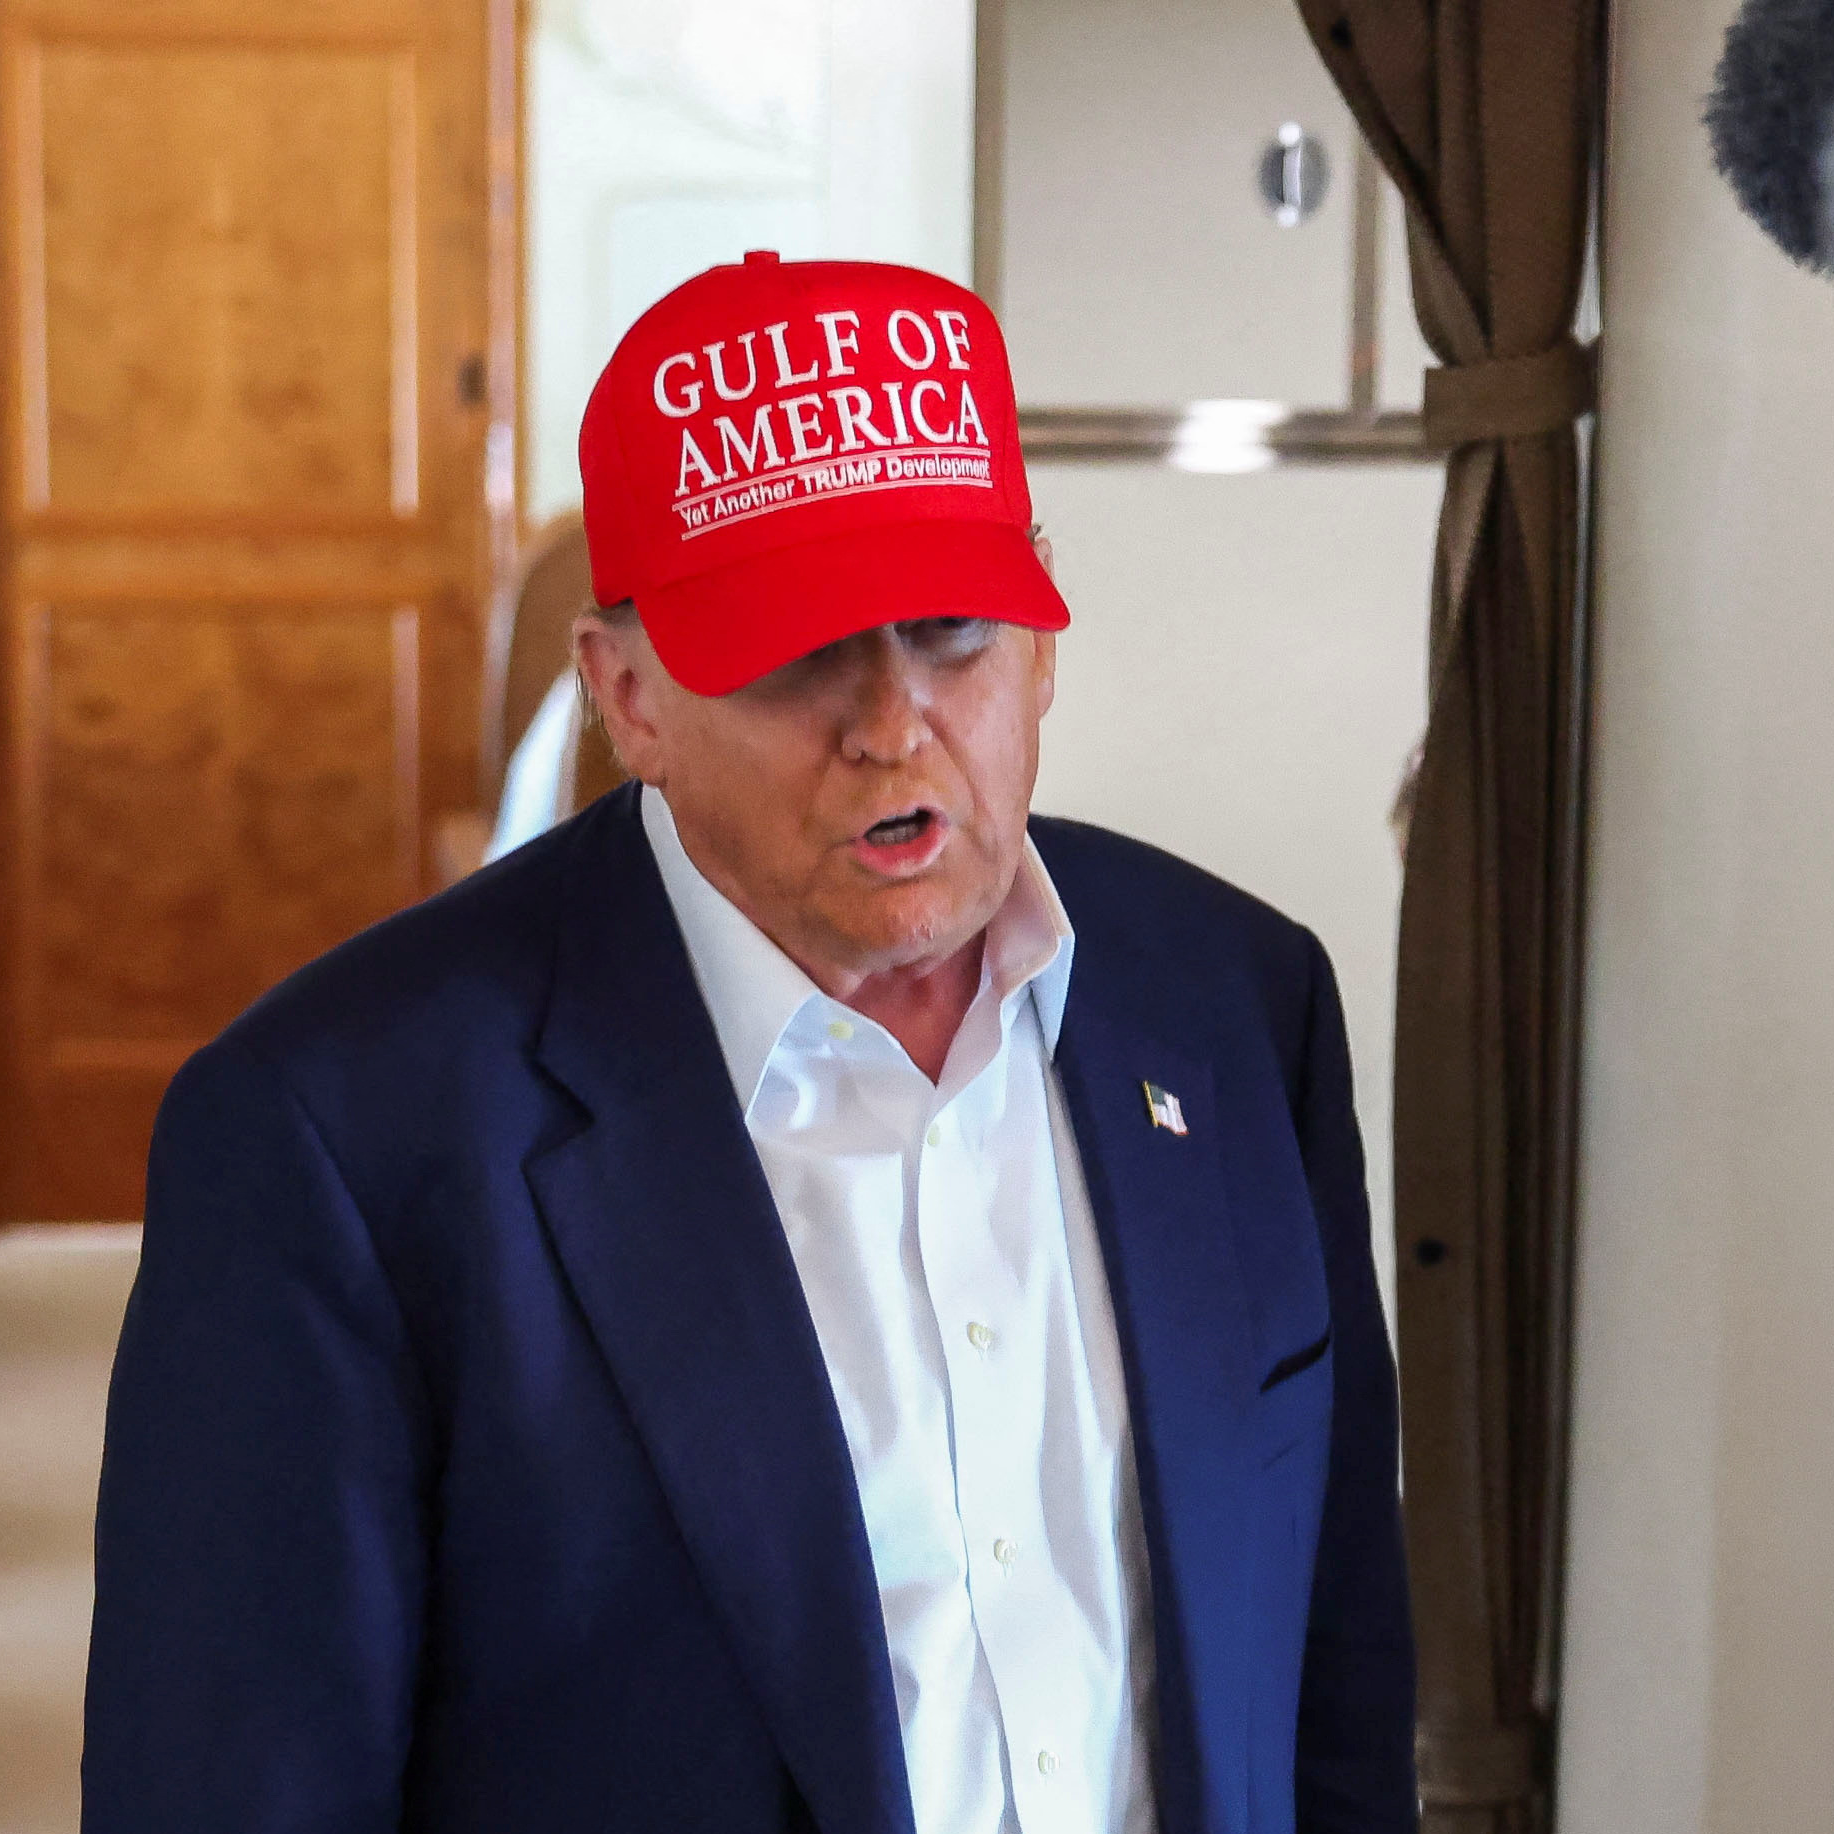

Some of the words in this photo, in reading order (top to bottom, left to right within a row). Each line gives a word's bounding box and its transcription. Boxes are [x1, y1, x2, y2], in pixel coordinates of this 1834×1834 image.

[653, 310, 860, 418] GULF
[887, 309, 970, 370] OF
[674, 379, 989, 497] AMERICA
[680, 502, 709, 529] Yet
[714, 478, 795, 520] Another
[802, 458, 881, 494] TRUMP
[886, 453, 991, 480] Development
